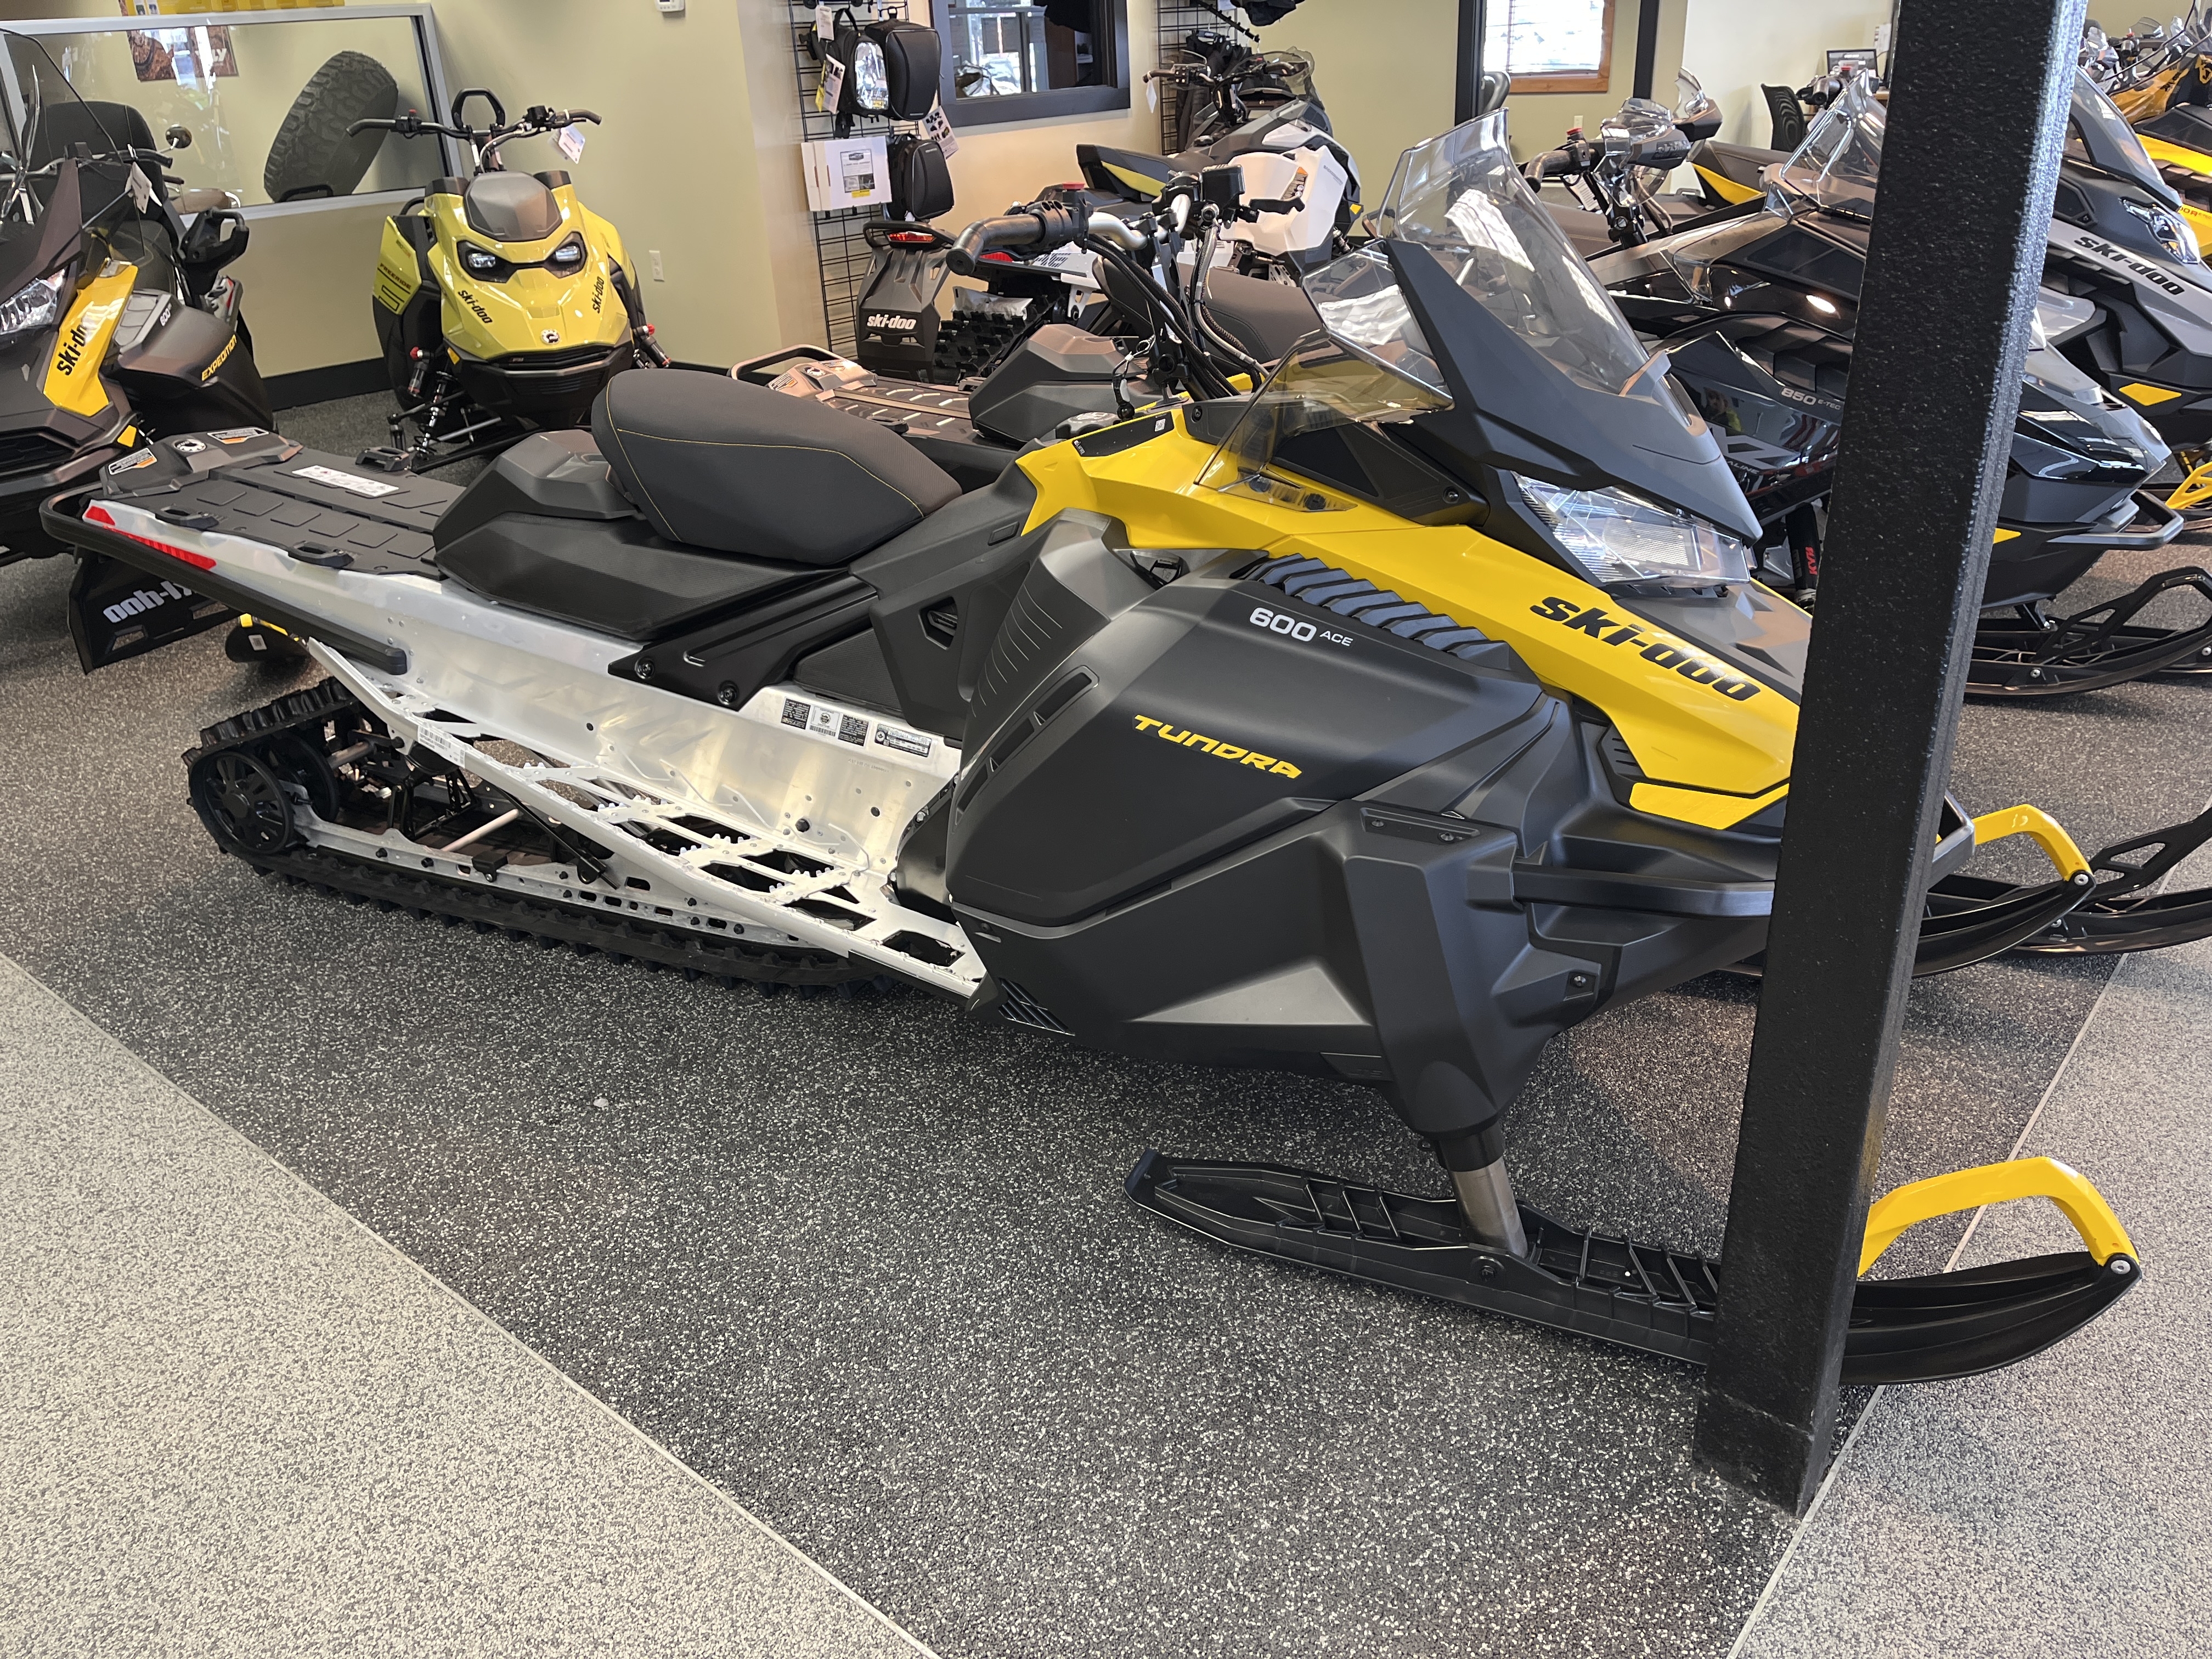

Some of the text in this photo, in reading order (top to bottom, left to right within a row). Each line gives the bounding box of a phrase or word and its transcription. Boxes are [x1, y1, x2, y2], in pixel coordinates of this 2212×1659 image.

[380, 263, 411, 290] FREERIDE
[2074, 236, 2185, 295] ski-doo
[458, 290, 493, 324] ski-doo
[592, 276, 605, 314] ski-doo
[867, 314, 917, 330] ski-doo
[57, 316, 90, 375] ski-do
[201, 334, 237, 381] EXPEDITION
[1781, 387, 1842, 410] 850 E-TEC
[1726, 461, 1760, 475] ALINE
[1805, 546, 1818, 575] KYB
[1249, 607, 1353, 647] 600 ACE
[1529, 596, 1761, 701] ski-doo
[1134, 714, 1302, 779] TUNDRA
